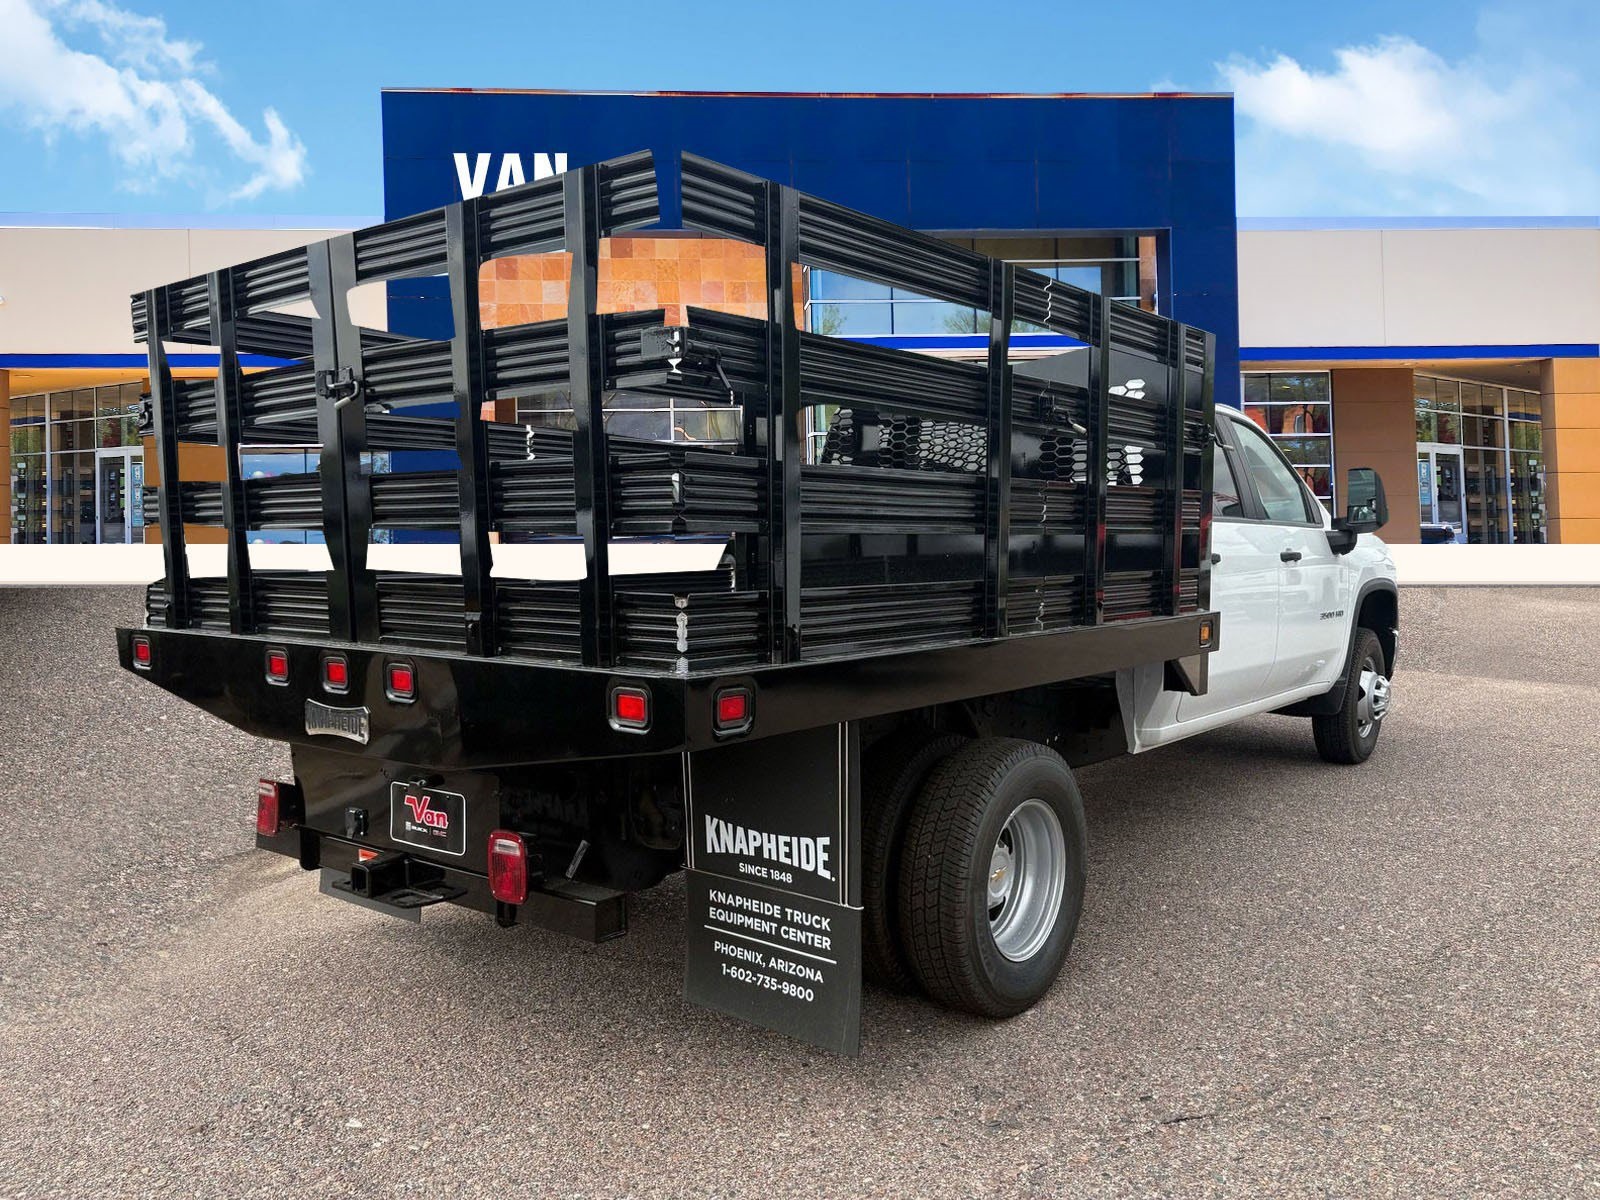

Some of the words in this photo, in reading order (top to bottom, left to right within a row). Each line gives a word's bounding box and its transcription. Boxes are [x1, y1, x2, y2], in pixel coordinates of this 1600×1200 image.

[404, 795, 449, 829] Van
[739, 862, 768, 878] SINCE
[769, 869, 793, 883] 1848
[709, 889, 781, 918] KNAPHEIDE
[785, 908, 831, 931] TRUCK
[709, 907, 778, 935] EQUIPMENT
[780, 926, 831, 950] CENTER
[714, 941, 766, 968] PHOENIX,
[768, 957, 824, 983] ARIZONA
[721, 963, 814, 1002] 1-602-735-9800
